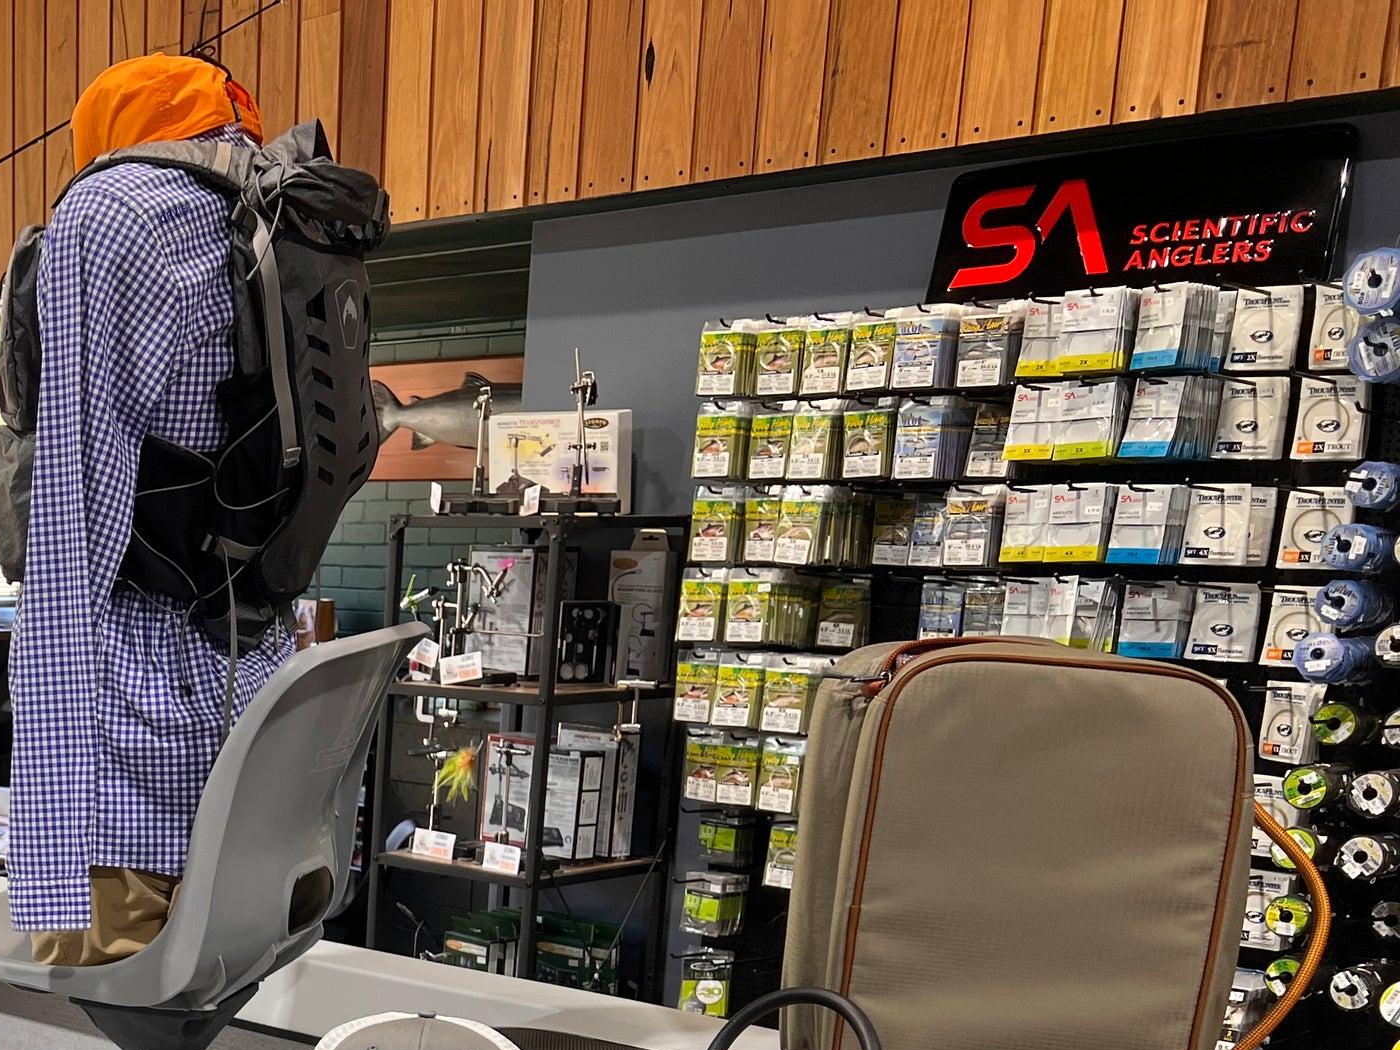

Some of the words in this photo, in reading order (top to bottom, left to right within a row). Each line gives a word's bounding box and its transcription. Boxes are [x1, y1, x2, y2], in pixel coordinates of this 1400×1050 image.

[947, 178, 1109, 292] SA
[1129, 210, 1317, 246] SCIENTIFIC
[1122, 239, 1274, 272] ANGLERS
[1313, 443, 1324, 451] 2X
